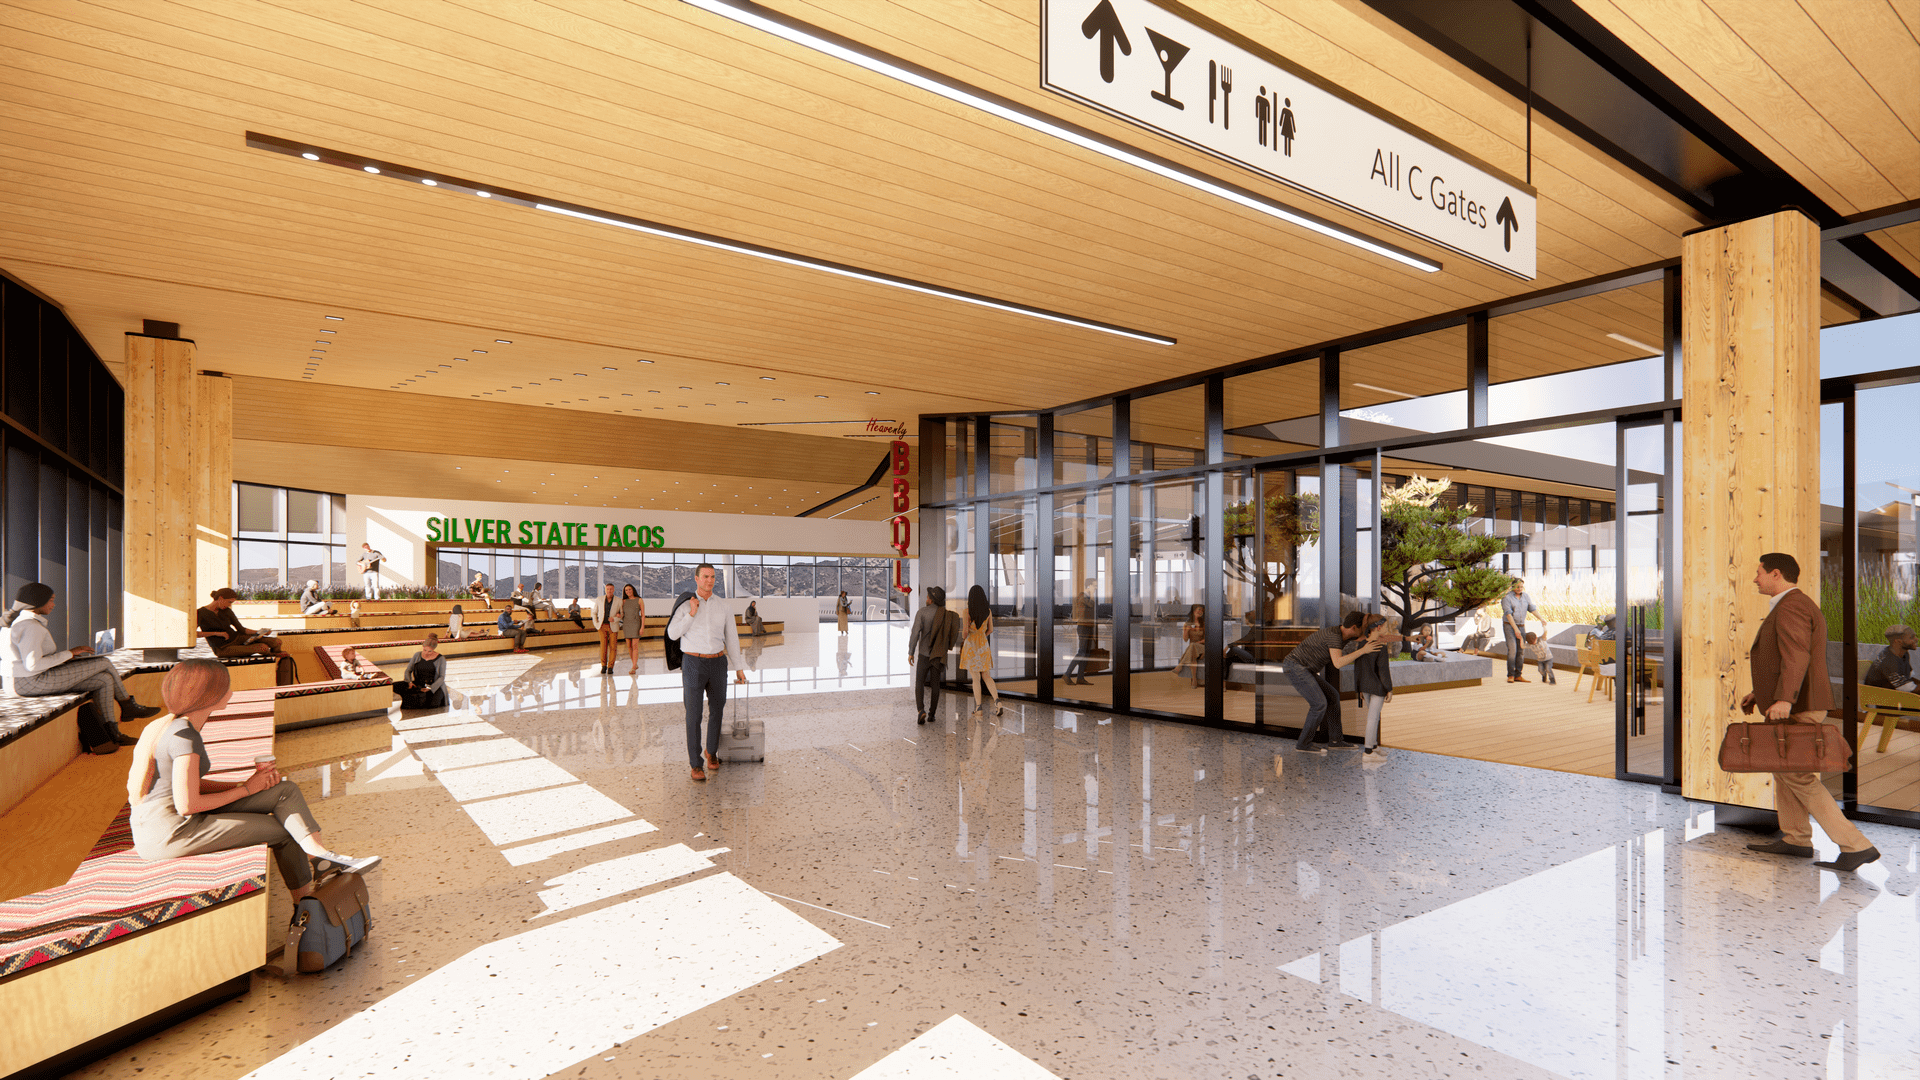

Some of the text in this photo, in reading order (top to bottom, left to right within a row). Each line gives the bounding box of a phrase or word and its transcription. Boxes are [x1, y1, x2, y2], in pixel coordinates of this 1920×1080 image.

[1370, 148, 1487, 229] All C Gates
[866, 417, 907, 440] Heavenly
[891, 441, 911, 557] BBQ
[426, 517, 665, 549] SILVER STATE TACOS
